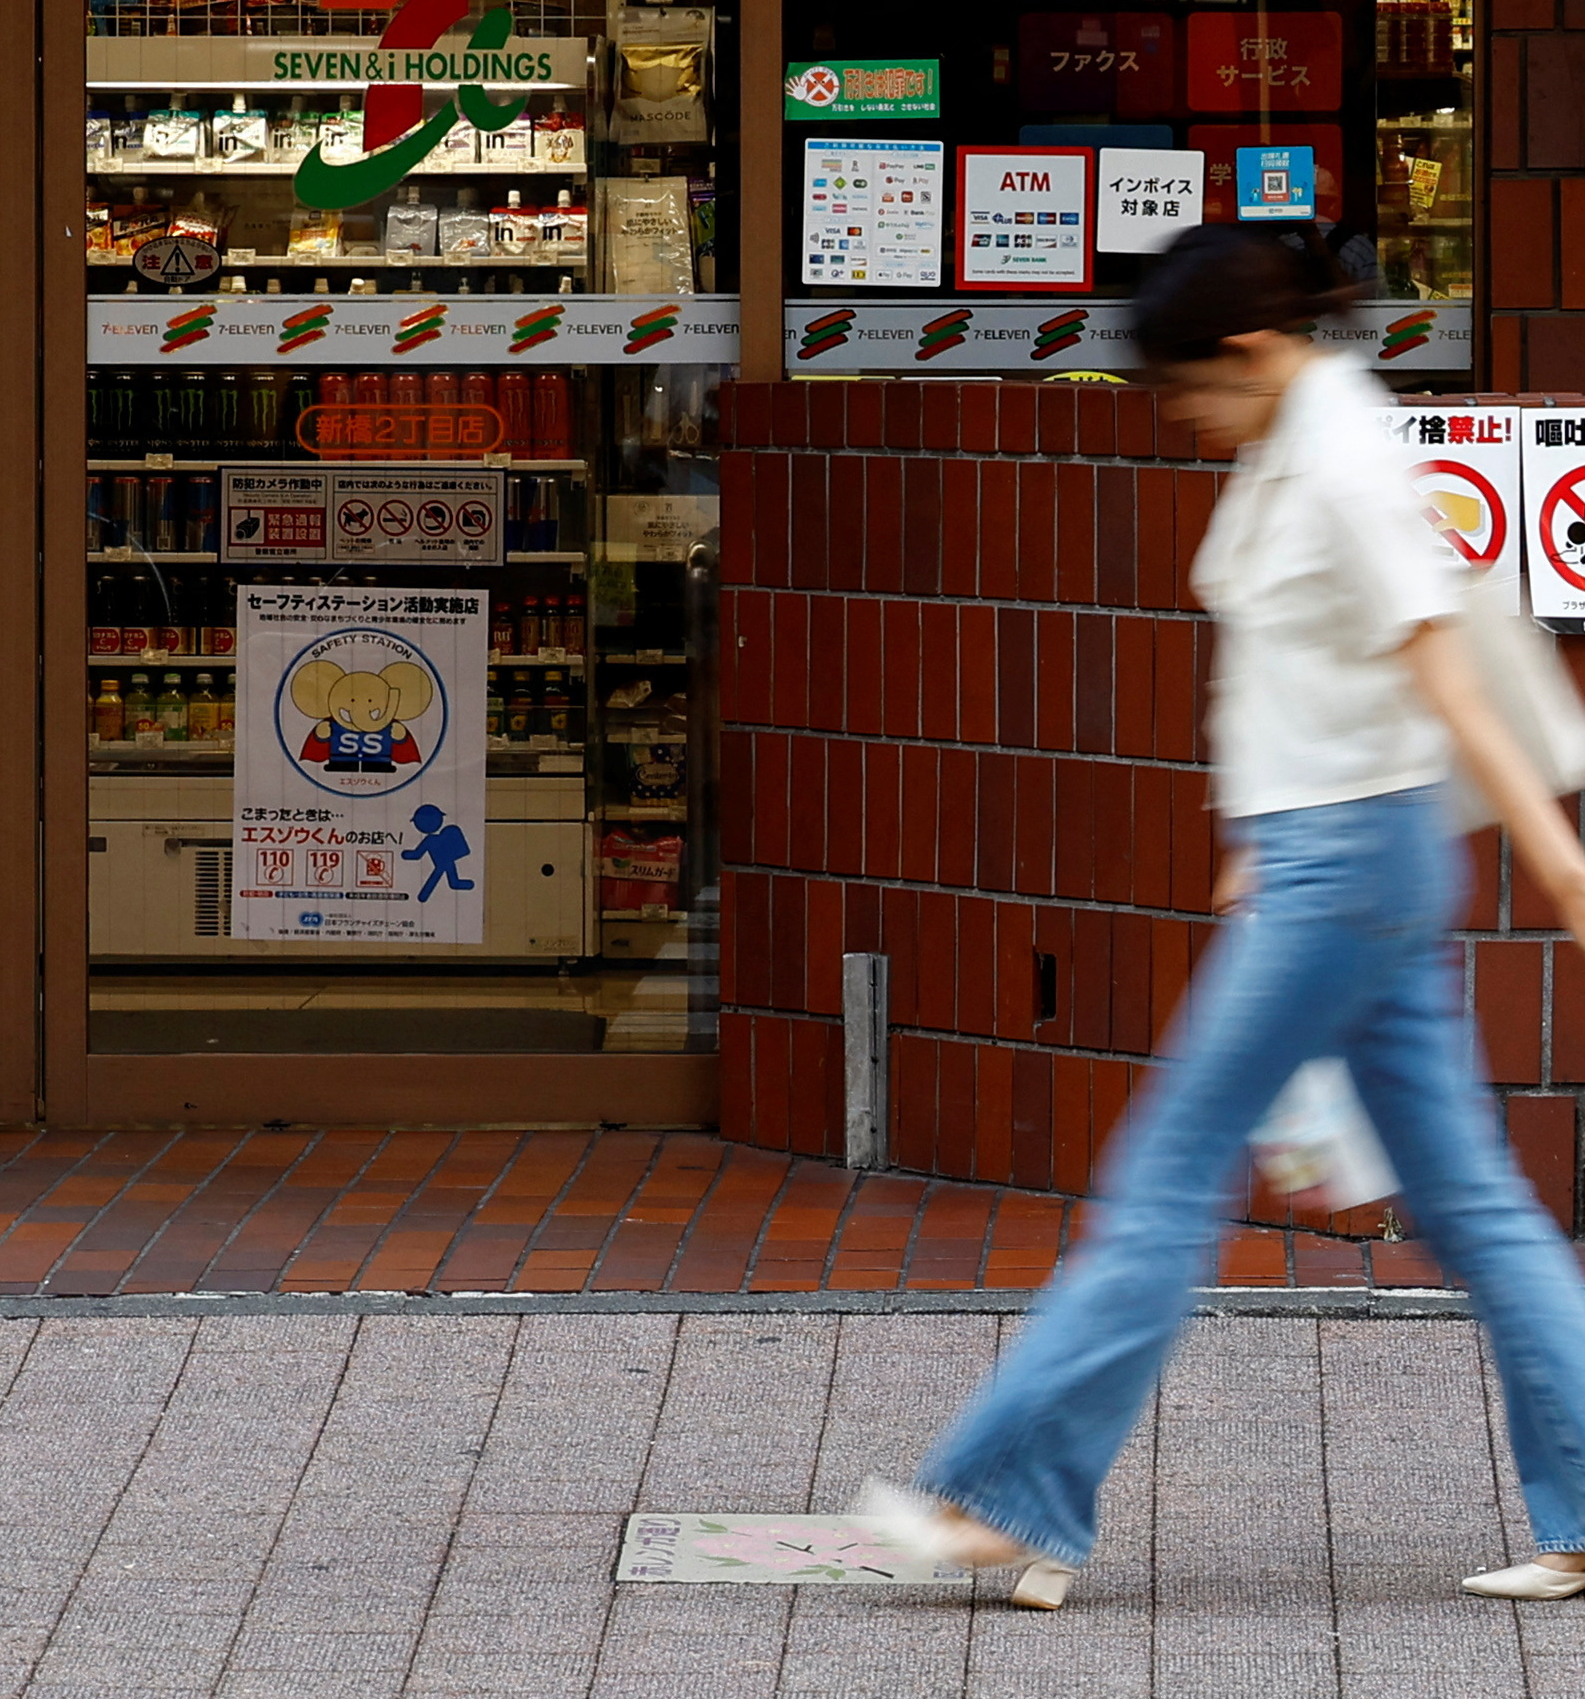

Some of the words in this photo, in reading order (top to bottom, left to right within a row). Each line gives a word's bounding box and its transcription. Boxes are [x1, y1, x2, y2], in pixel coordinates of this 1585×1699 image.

[1239, 37, 1288, 61] 行政
[404, 50, 552, 81] HOLDINGS
[1049, 50, 1141, 74] ファクス
[1216, 64, 1311, 88] サービス
[1000, 171, 1052, 192] ATM
[1108, 176, 1194, 195] インボイス
[1121, 199, 1181, 217] 対象店
[142, 254, 161, 270] 注
[314, 415, 485, 446] 新橋2丁目店
[247, 592, 479, 615] セーフティステーション活動実施店
[311, 633, 358, 659] SAFETY
[361, 633, 413, 660] STATION
[338, 732, 384, 755] SS
[240, 825, 404, 845] エスゾウくんのお店へ!
[260, 851, 290, 868] 110
[309, 852, 340, 868] 119
